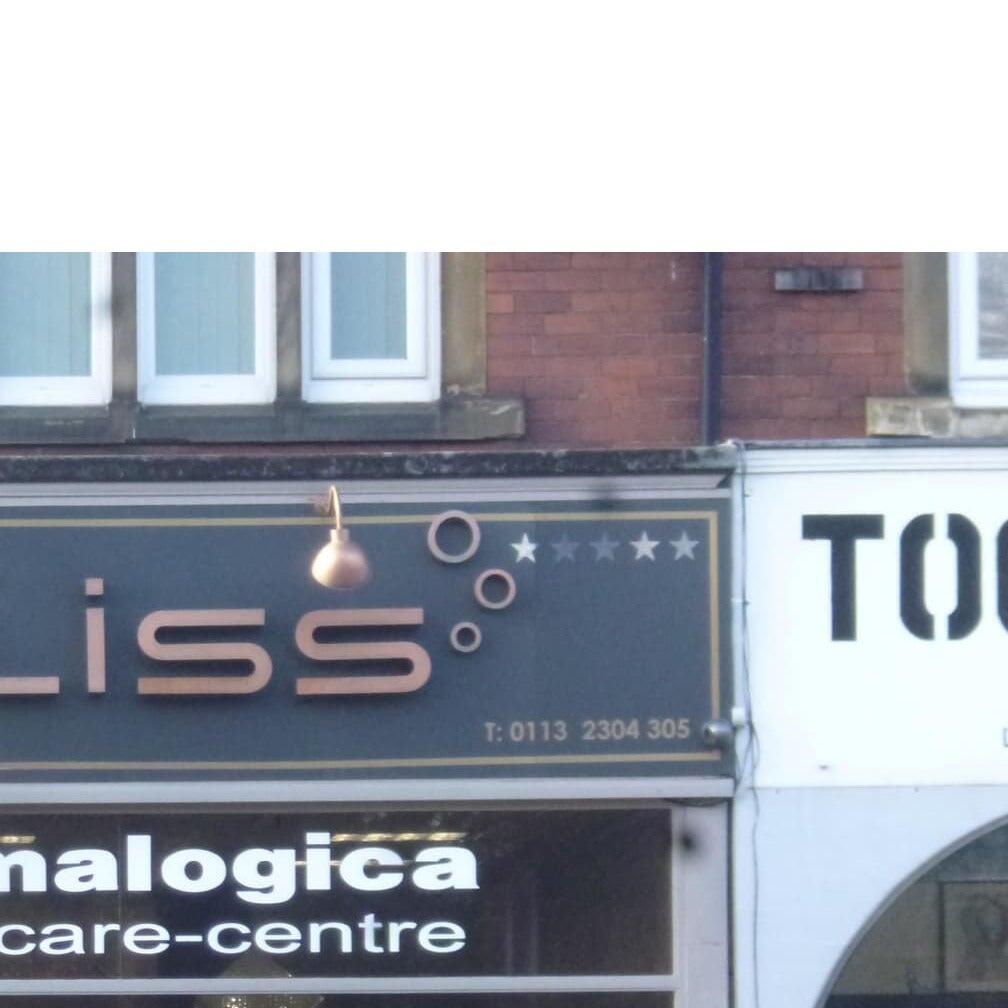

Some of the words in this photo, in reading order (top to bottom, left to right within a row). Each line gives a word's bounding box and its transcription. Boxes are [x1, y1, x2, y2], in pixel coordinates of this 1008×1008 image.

[801, 512, 1008, 641] TO
[484, 721, 503, 742] T:
[509, 720, 568, 742] 0113
[582, 719, 640, 741] 2304
[647, 718, 691, 740] 305
